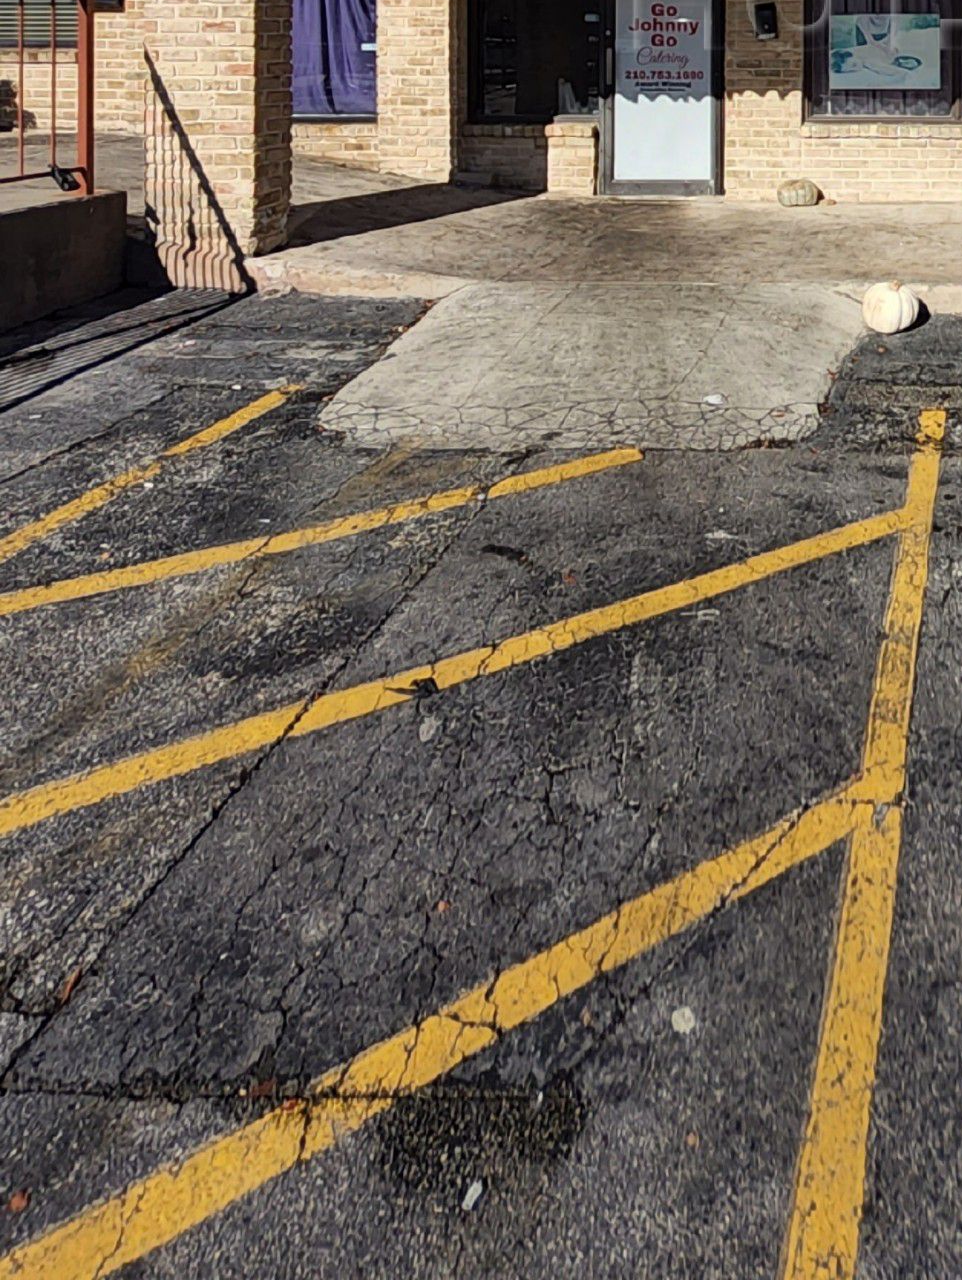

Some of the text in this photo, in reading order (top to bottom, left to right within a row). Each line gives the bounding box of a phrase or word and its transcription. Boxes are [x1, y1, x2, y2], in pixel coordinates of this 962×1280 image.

[651, 3, 678, 17] Go
[628, 18, 700, 36] Johnny
[651, 34, 678, 47] Go
[636, 46, 690, 69] Catering
